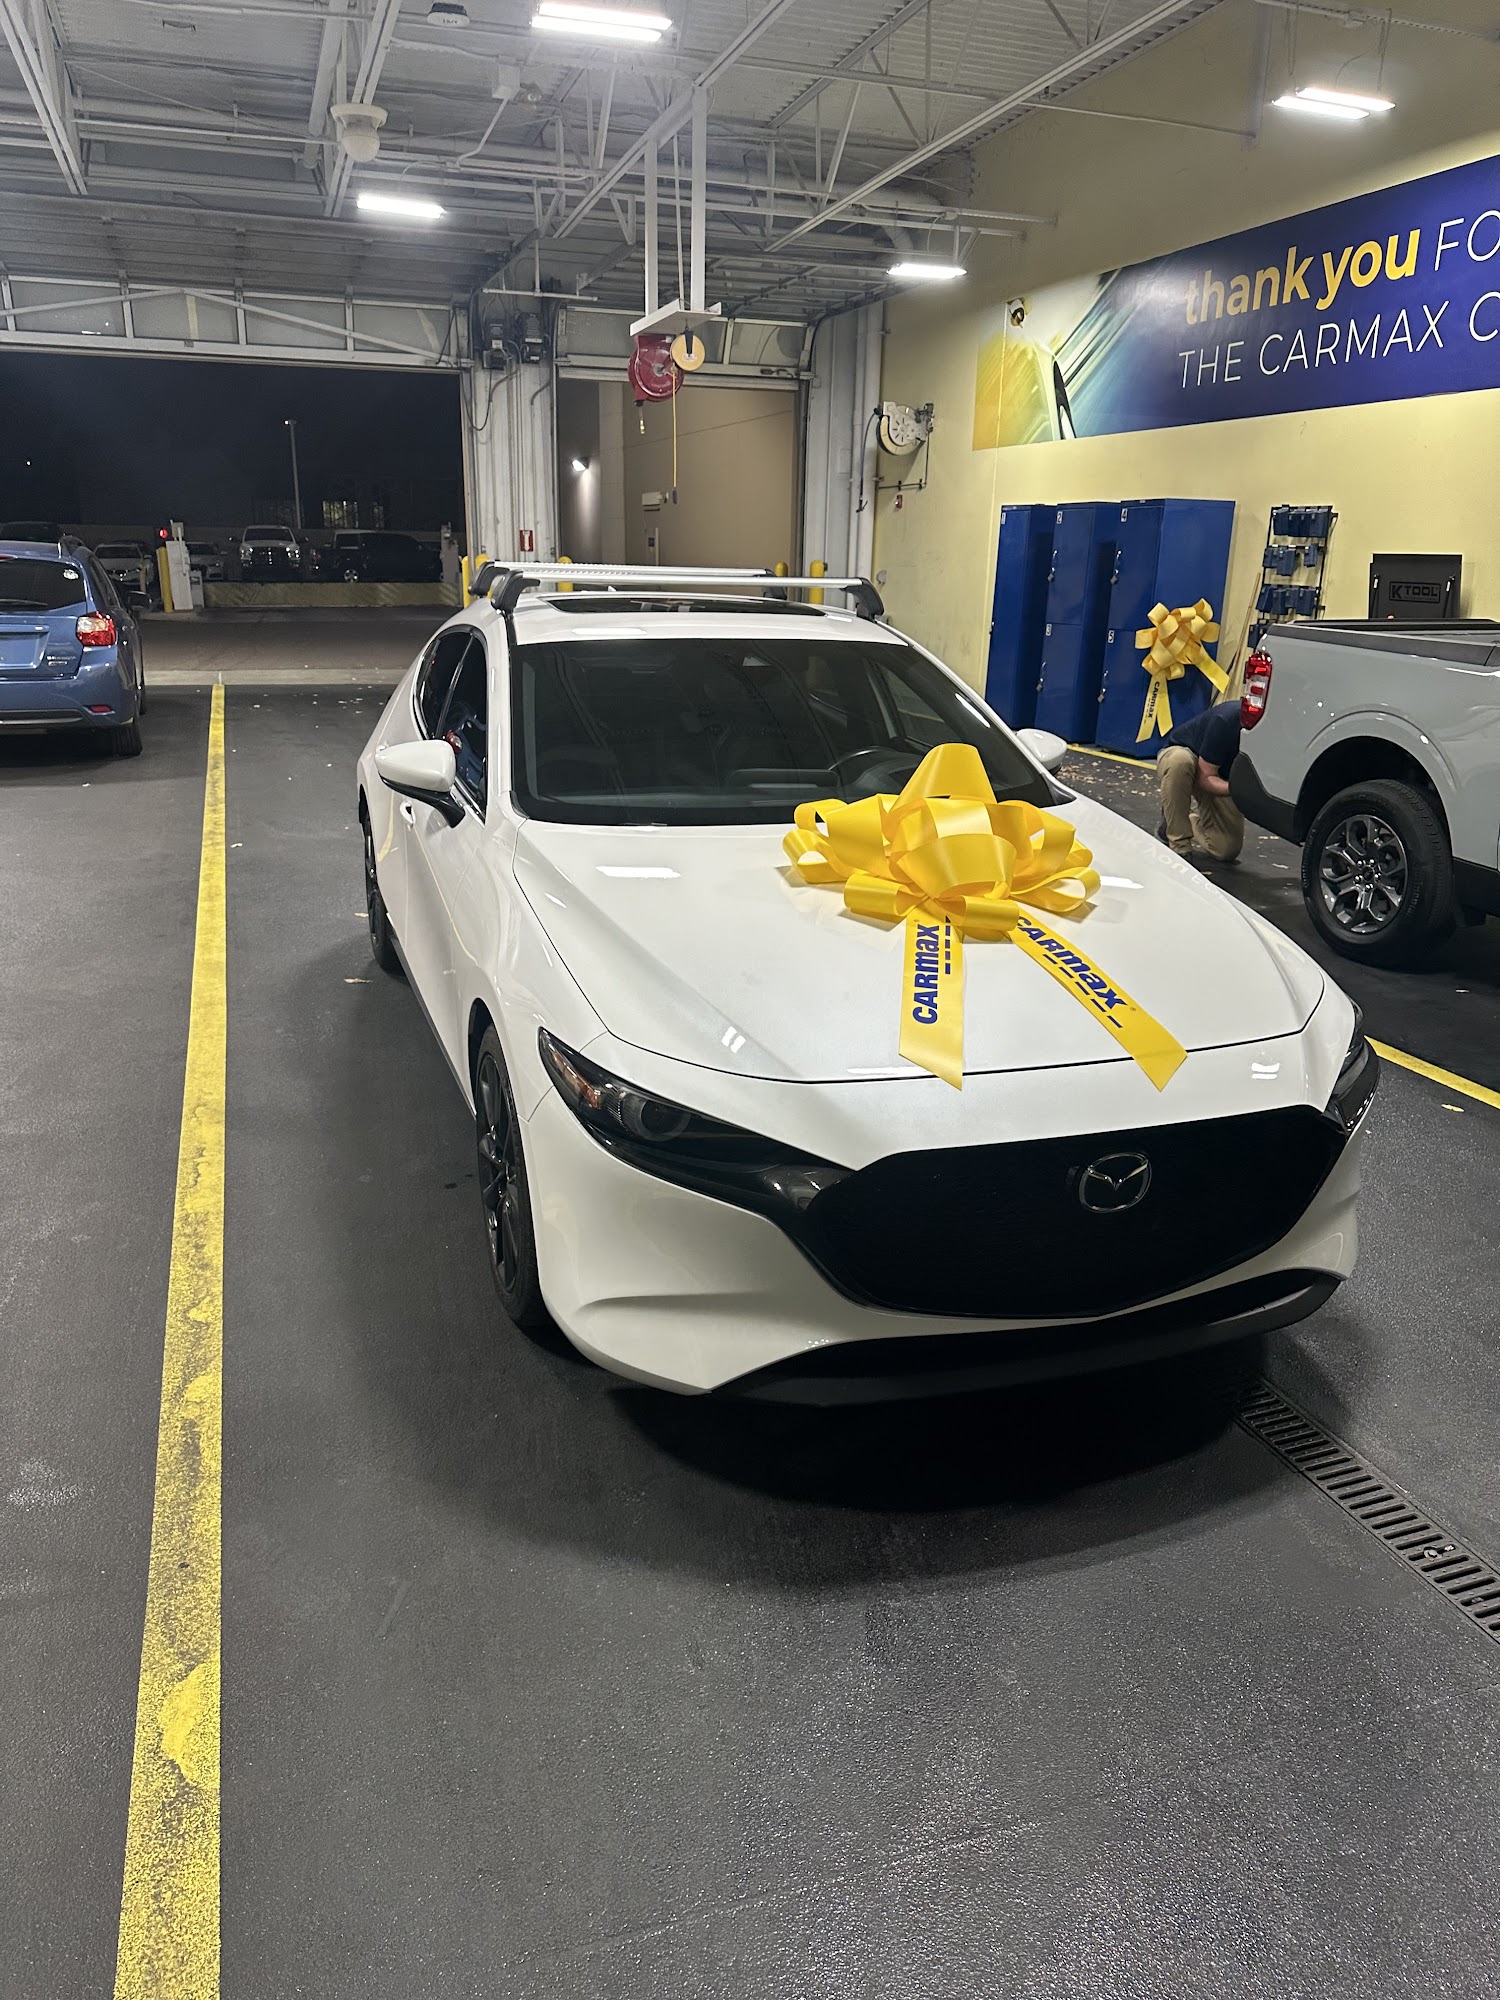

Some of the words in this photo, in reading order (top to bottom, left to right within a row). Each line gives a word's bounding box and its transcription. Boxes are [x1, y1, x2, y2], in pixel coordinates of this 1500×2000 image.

[1184, 245, 1314, 325] thank
[1315, 228, 1421, 311] you
[1434, 210, 1500, 271] FO
[1178, 340, 1245, 389] THE
[1259, 300, 1450, 376] CARMAX
